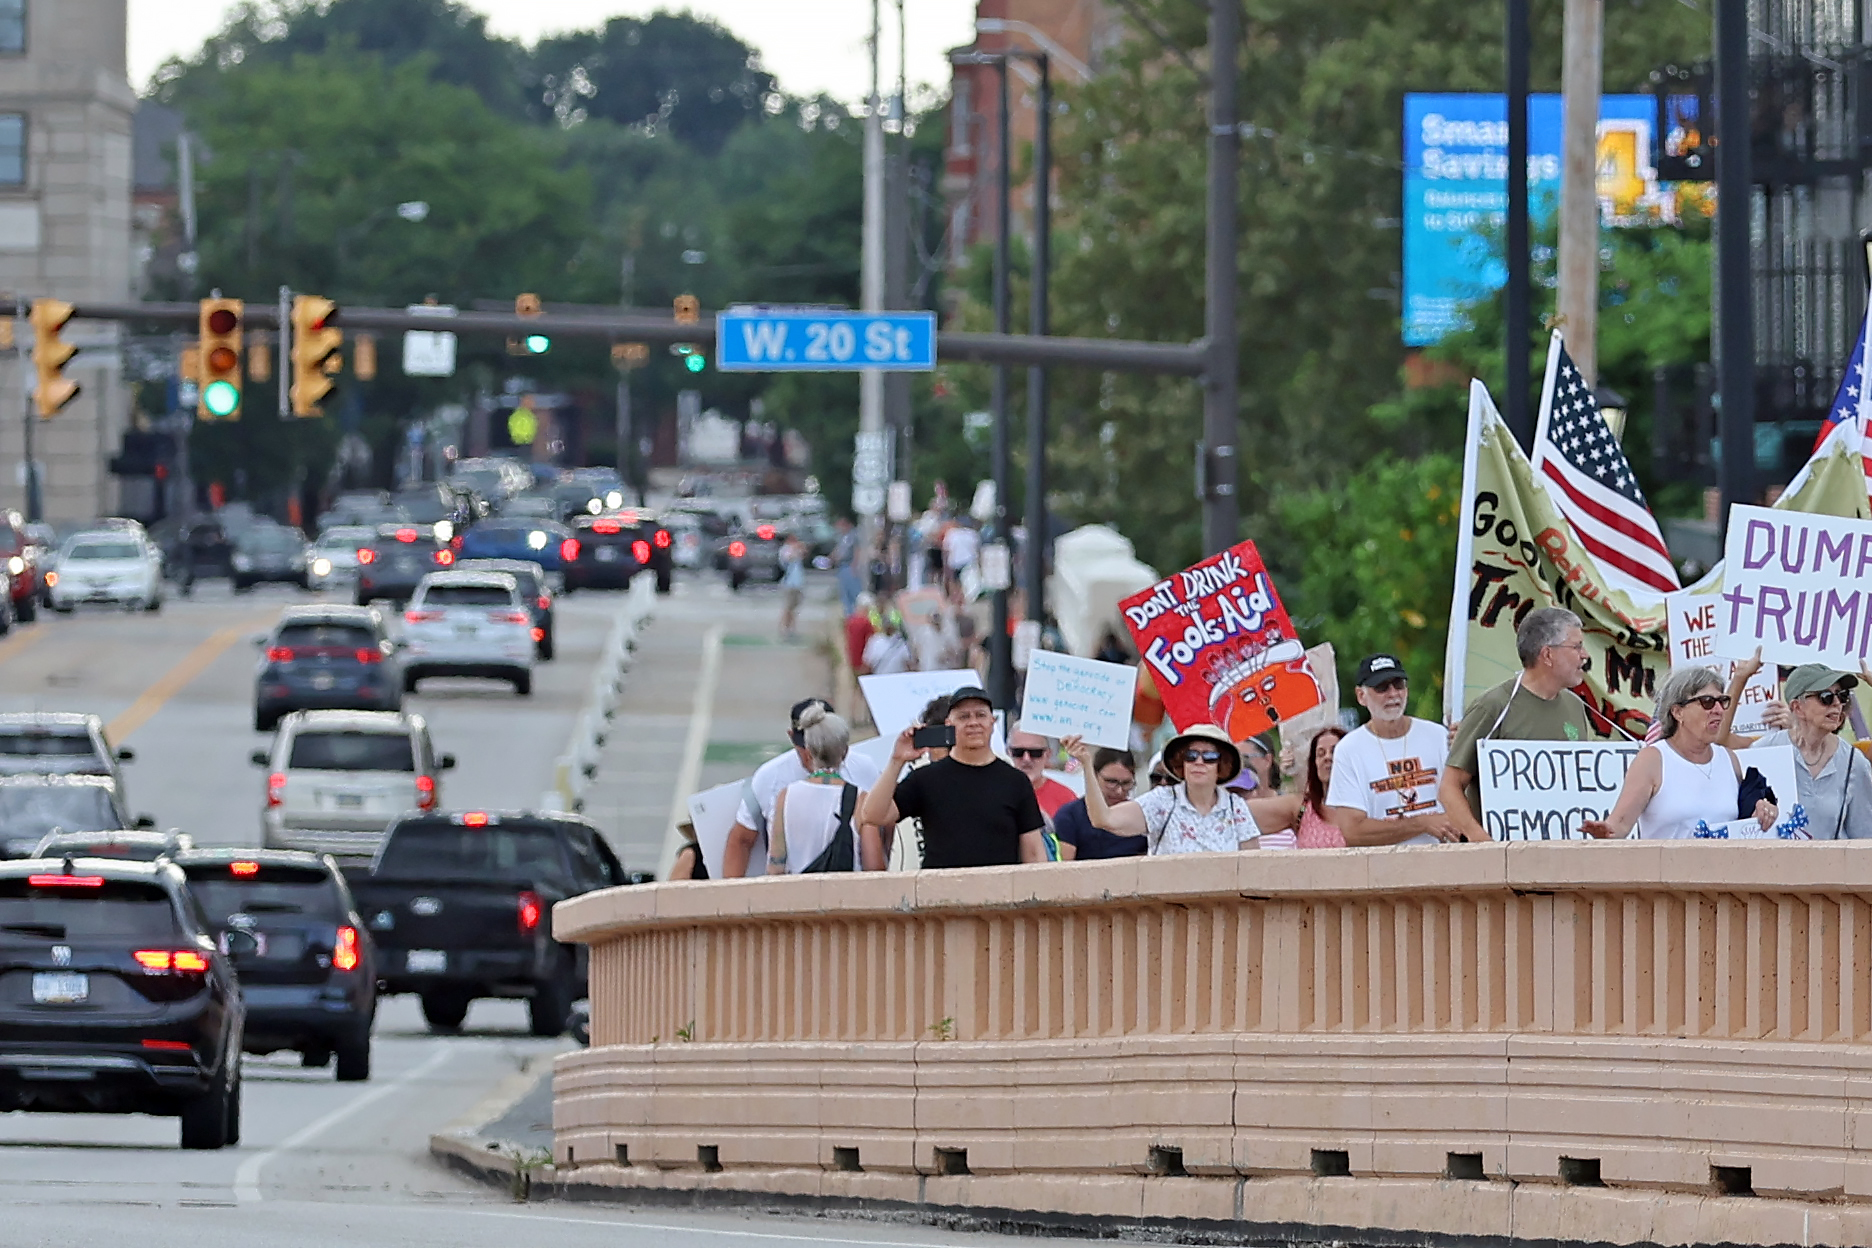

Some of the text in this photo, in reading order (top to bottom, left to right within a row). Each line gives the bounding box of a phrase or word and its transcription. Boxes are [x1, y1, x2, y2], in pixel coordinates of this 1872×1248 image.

[1422, 113, 1510, 146] Smar
[741, 320, 914, 362] W. 20 St
[1173, 599, 1201, 617] THE
[1684, 604, 1716, 632] WE
[1680, 635, 1714, 660] THE
[1744, 684, 1775, 705] FEW
[1488, 749, 1640, 793] PROTECT
